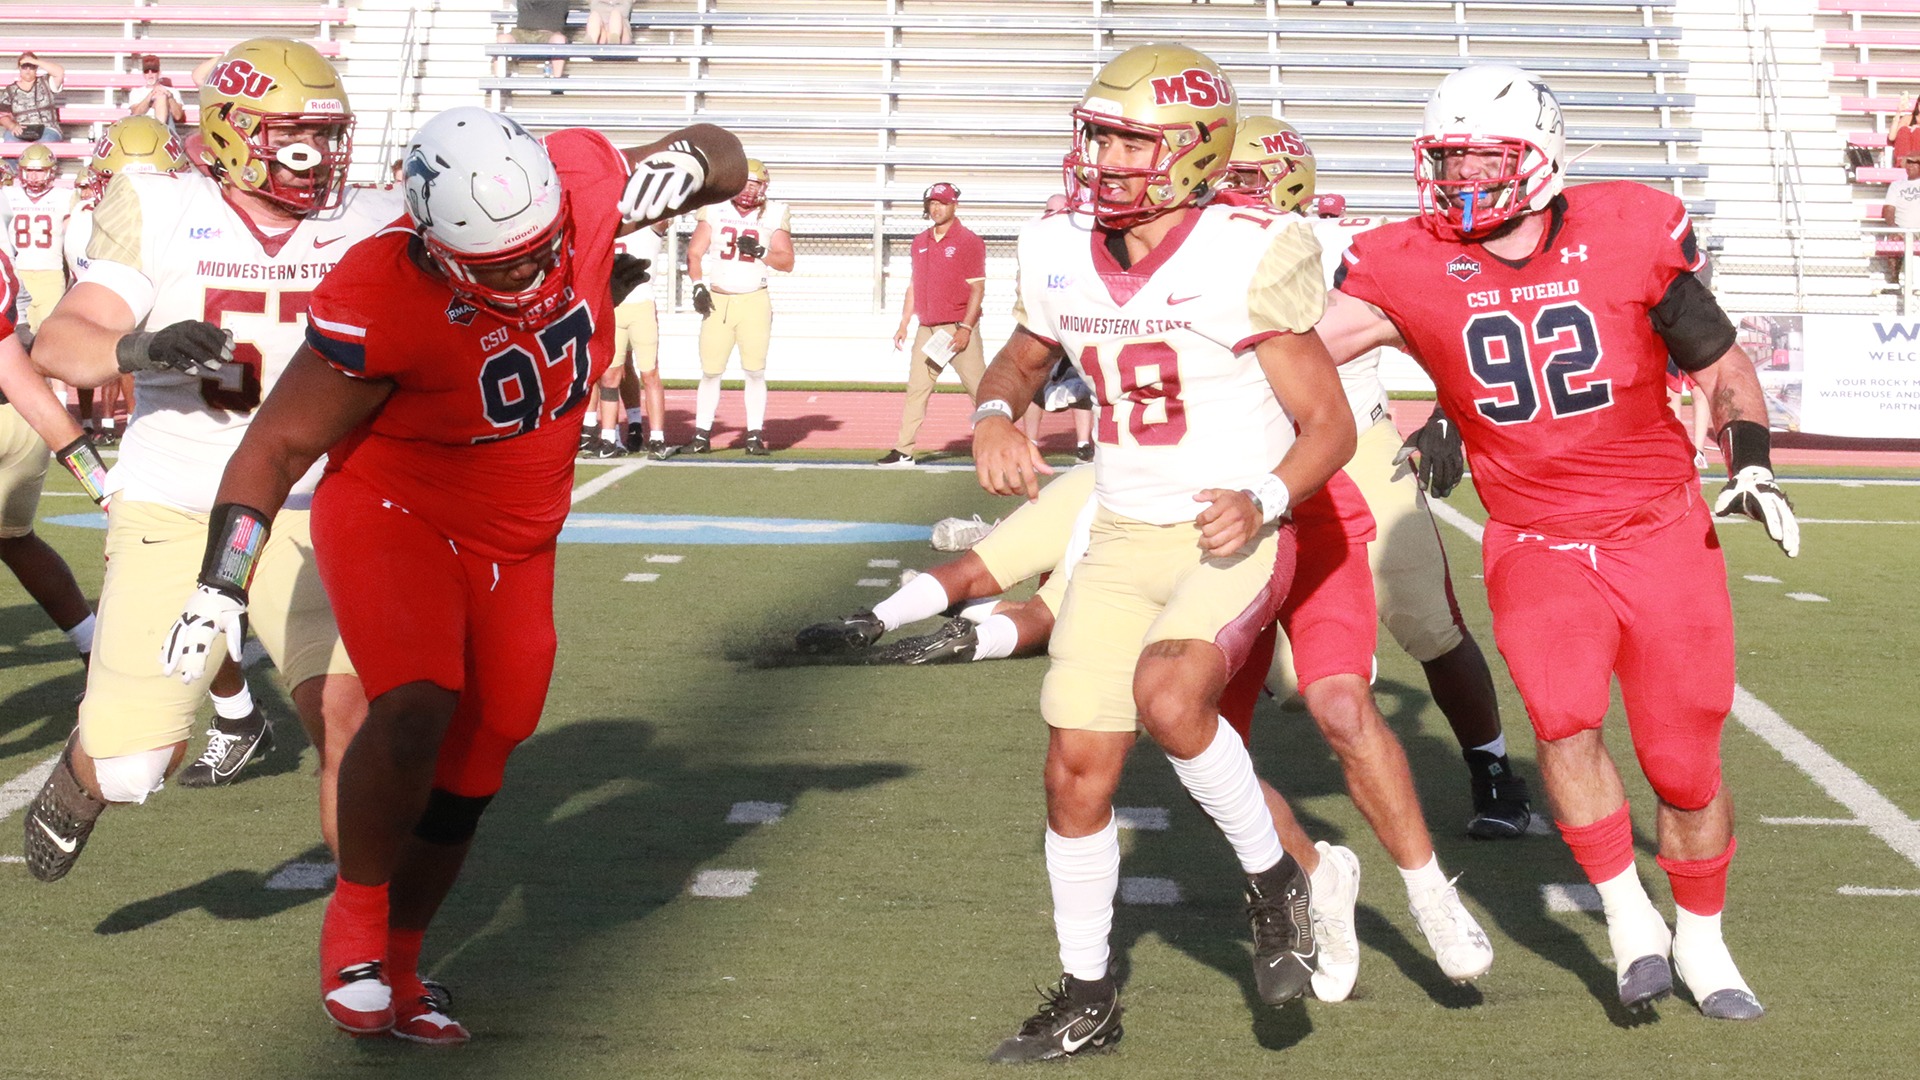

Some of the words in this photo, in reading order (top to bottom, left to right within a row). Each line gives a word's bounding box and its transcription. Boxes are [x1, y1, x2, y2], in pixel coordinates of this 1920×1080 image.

[1151, 69, 1231, 109] MSU
[311, 101, 341, 110] Riddell
[14, 214, 53, 249] 83
[197, 260, 298, 281] MIDWESTERN
[1449, 262, 1480, 273] RMAC
[1466, 289, 1500, 308] CSU
[1510, 278, 1580, 303] PUEBLO
[1059, 314, 1141, 335] MIDWESTERN
[479, 325, 509, 352] CSU
[470, 298, 596, 446] 97
[1461, 300, 1616, 427] 92
[1078, 340, 1189, 447] 18
[1819, 390, 1894, 399] WAREHOUSE
[1836, 378, 1867, 387] YOUR
[1870, 378, 1908, 387] ROCKY
